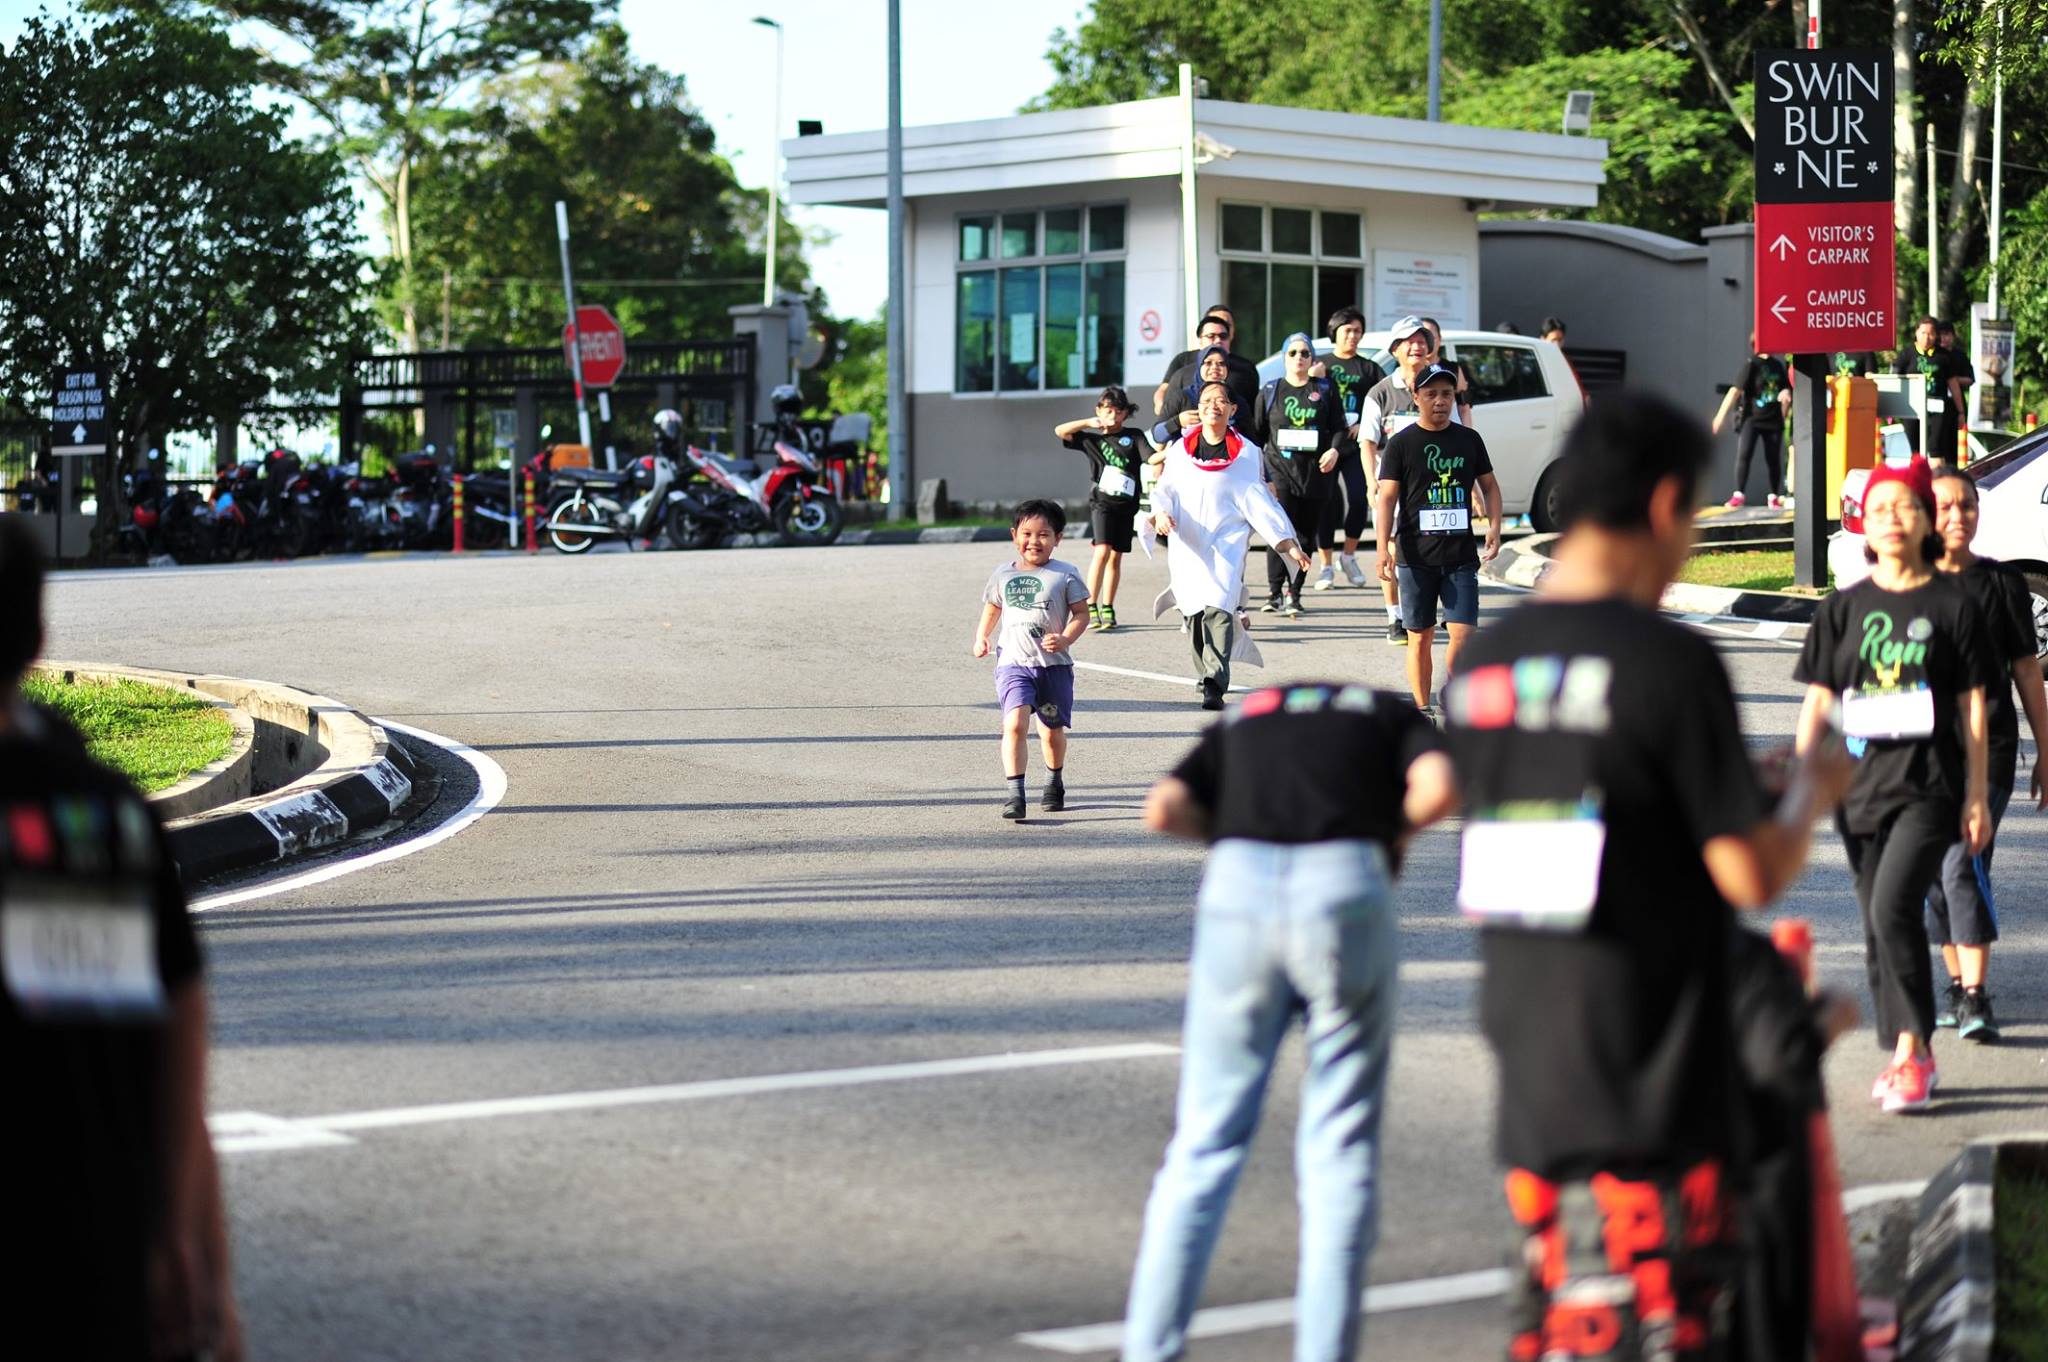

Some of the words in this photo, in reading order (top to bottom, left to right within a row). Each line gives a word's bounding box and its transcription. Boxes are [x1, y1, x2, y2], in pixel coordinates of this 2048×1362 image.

[1784, 106, 1870, 146] BUR
[1797, 150, 1859, 189] NE
[1807, 225, 1875, 243] VISITOR'S
[1807, 247, 1870, 265] CARPARK
[1807, 289, 1866, 307] CAMPUS
[1807, 311, 1885, 329] RESIDENCE
[65, 373, 81, 389] EXIT
[82, 372, 96, 388] FOR
[57, 390, 84, 406] SEASON
[84, 388, 102, 404] PASS
[54, 406, 85, 422] HOLDERS
[86, 405, 105, 420] ONLY
[1283, 396, 1317, 421] Run
[1423, 443, 1465, 472] Run
[1431, 512, 1458, 528] 170
[1007, 587, 1038, 595] LEAGUE
[1019, 578, 1039, 587] WEST
[1859, 610, 1927, 670] Run
